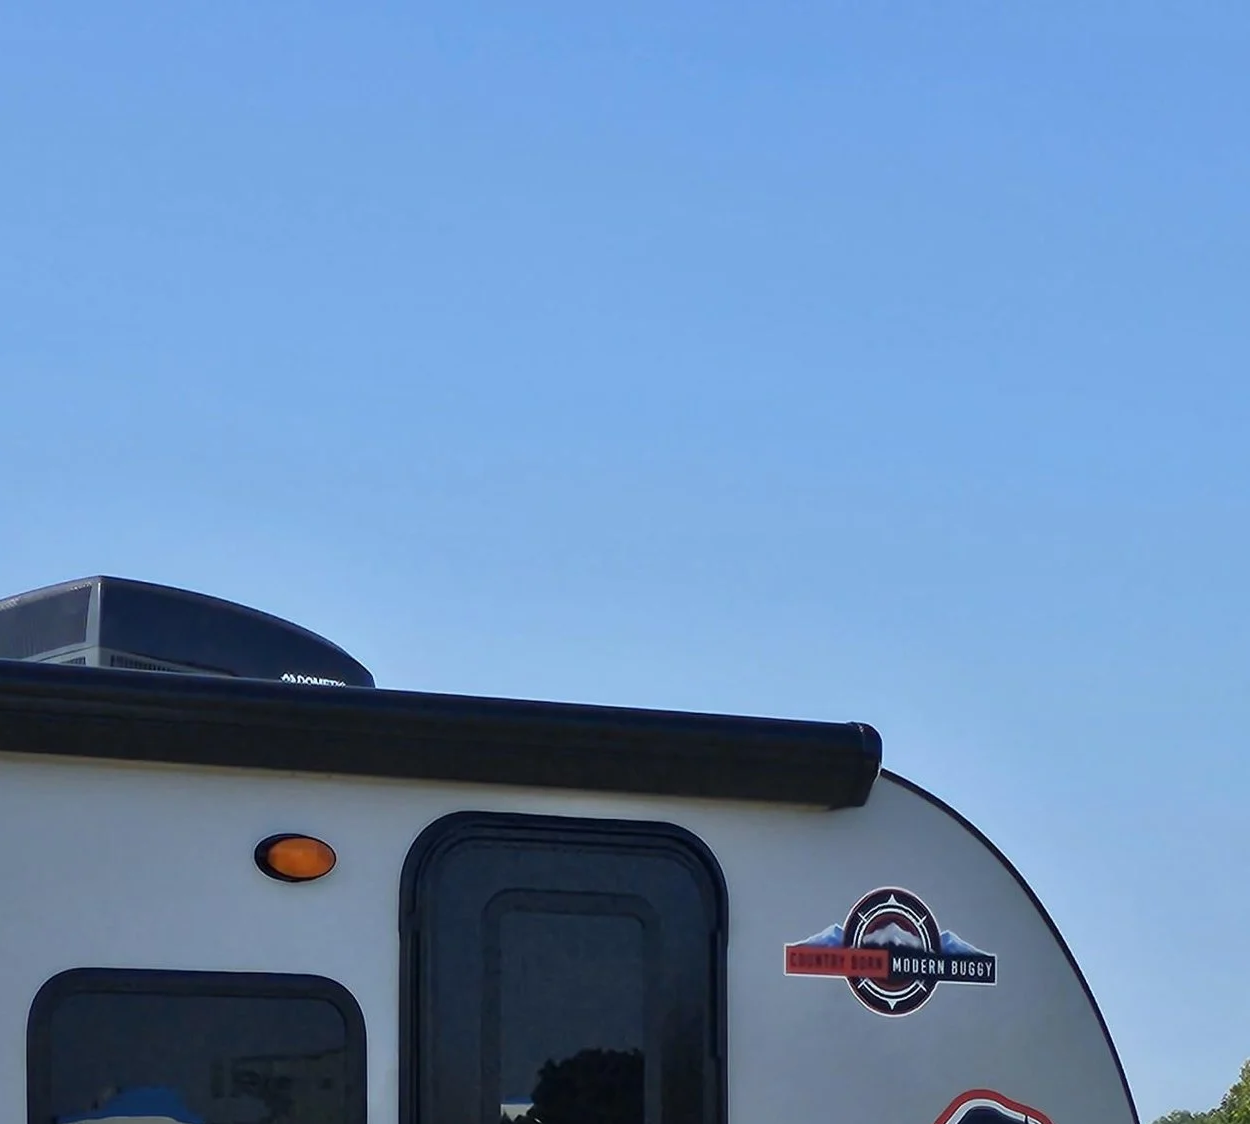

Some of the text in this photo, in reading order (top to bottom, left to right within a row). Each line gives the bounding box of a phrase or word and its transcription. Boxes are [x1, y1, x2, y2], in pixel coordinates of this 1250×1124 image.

[789, 953, 845, 969] COUNTRY
[892, 957, 945, 974] MODERN
[951, 960, 993, 977] BUGGY
